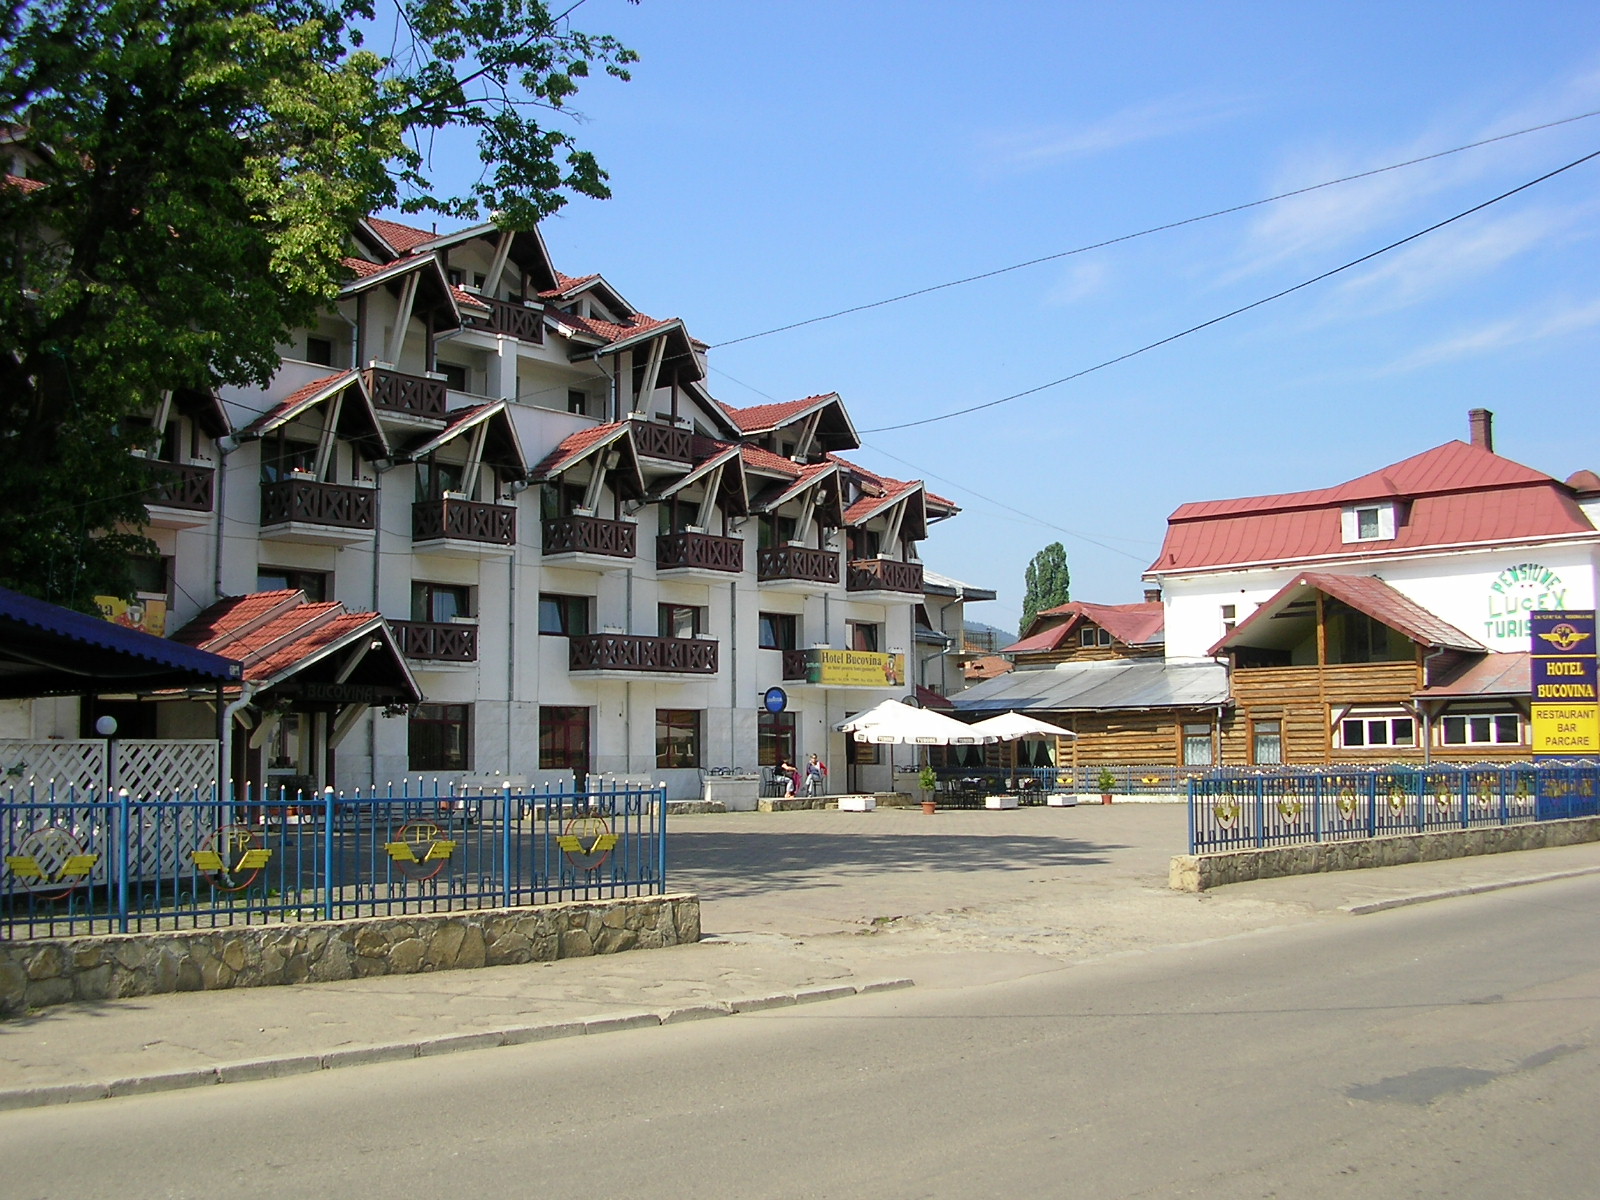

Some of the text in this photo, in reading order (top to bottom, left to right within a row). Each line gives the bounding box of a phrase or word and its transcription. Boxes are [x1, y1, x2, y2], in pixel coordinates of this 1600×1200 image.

[1491, 563, 1562, 594] PENSIUNE
[1484, 619, 1532, 639] TURIS
[822, 651, 882, 666] Hotel Bucovina
[1546, 662, 1585, 676] HOTEL
[307, 684, 373, 701] BUCOVINA
[1537, 684, 1595, 698] BUCOVINA
[1536, 709, 1595, 720] RESTAURANT
[1557, 723, 1577, 733] BAR
[1545, 736, 1590, 746] PARCARE
